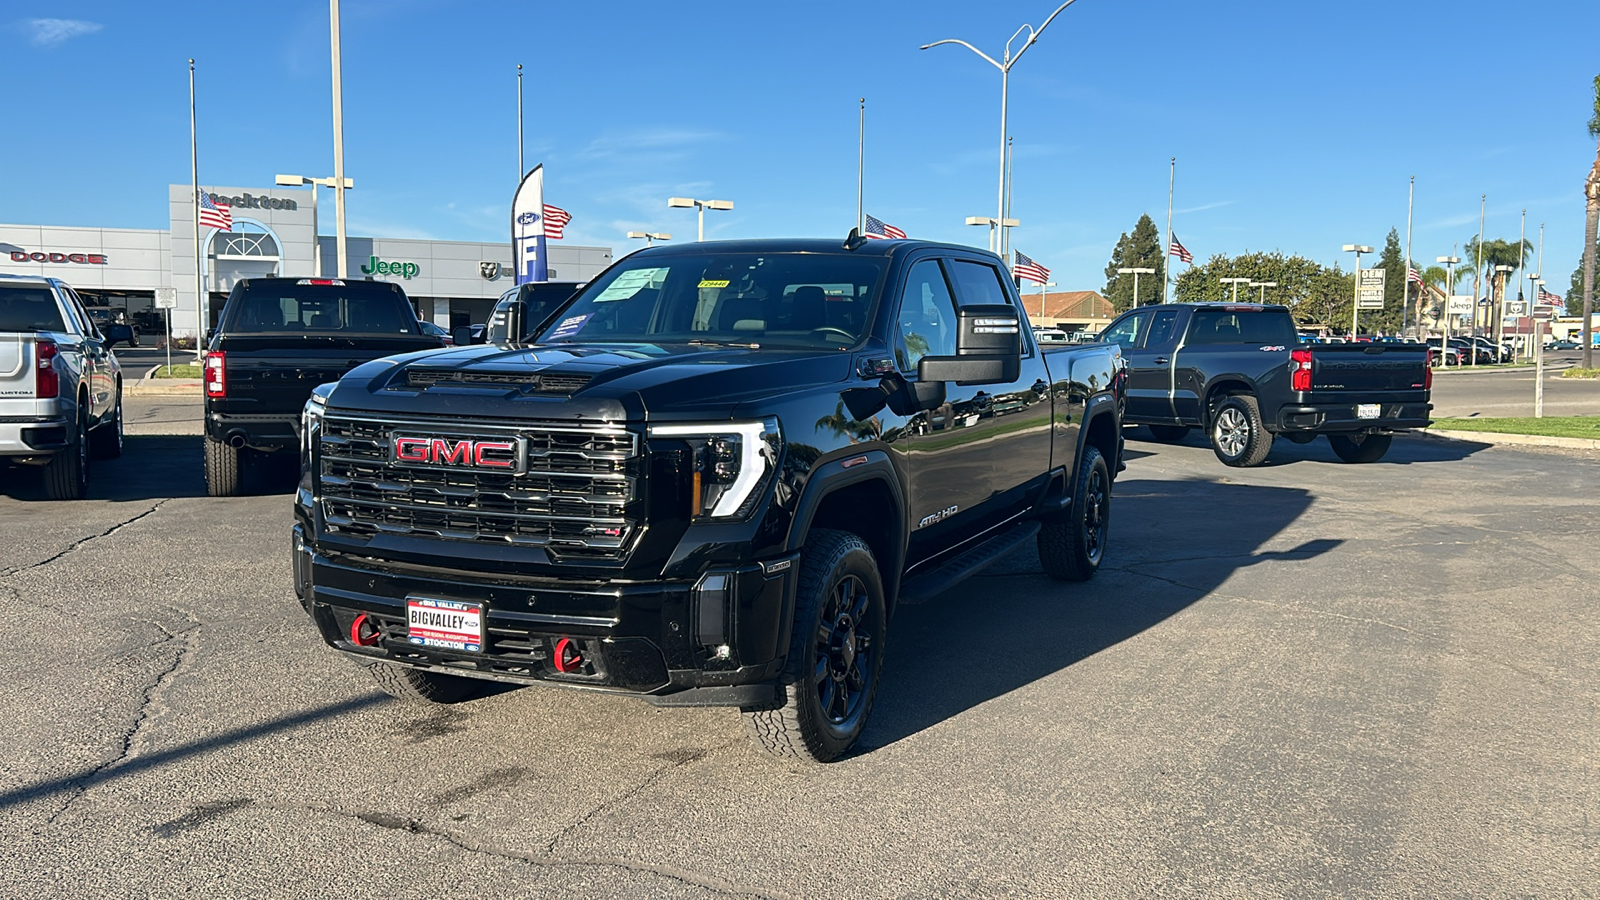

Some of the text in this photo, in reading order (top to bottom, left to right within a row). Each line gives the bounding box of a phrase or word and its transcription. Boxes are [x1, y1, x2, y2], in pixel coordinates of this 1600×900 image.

[192, 191, 297, 210] tockton
[11, 251, 106, 264] DODGE
[517, 237, 538, 276] F
[361, 256, 417, 278] Jeep
[1361, 270, 1383, 278] OEM
[1450, 301, 1472, 310] Jeep
[396, 437, 515, 468] GMC
[942, 505, 958, 518] HD
[437, 601, 463, 609] VALLEY
[411, 610, 465, 629] BIGVALLEY
[424, 638, 465, 649] STOCKTON
